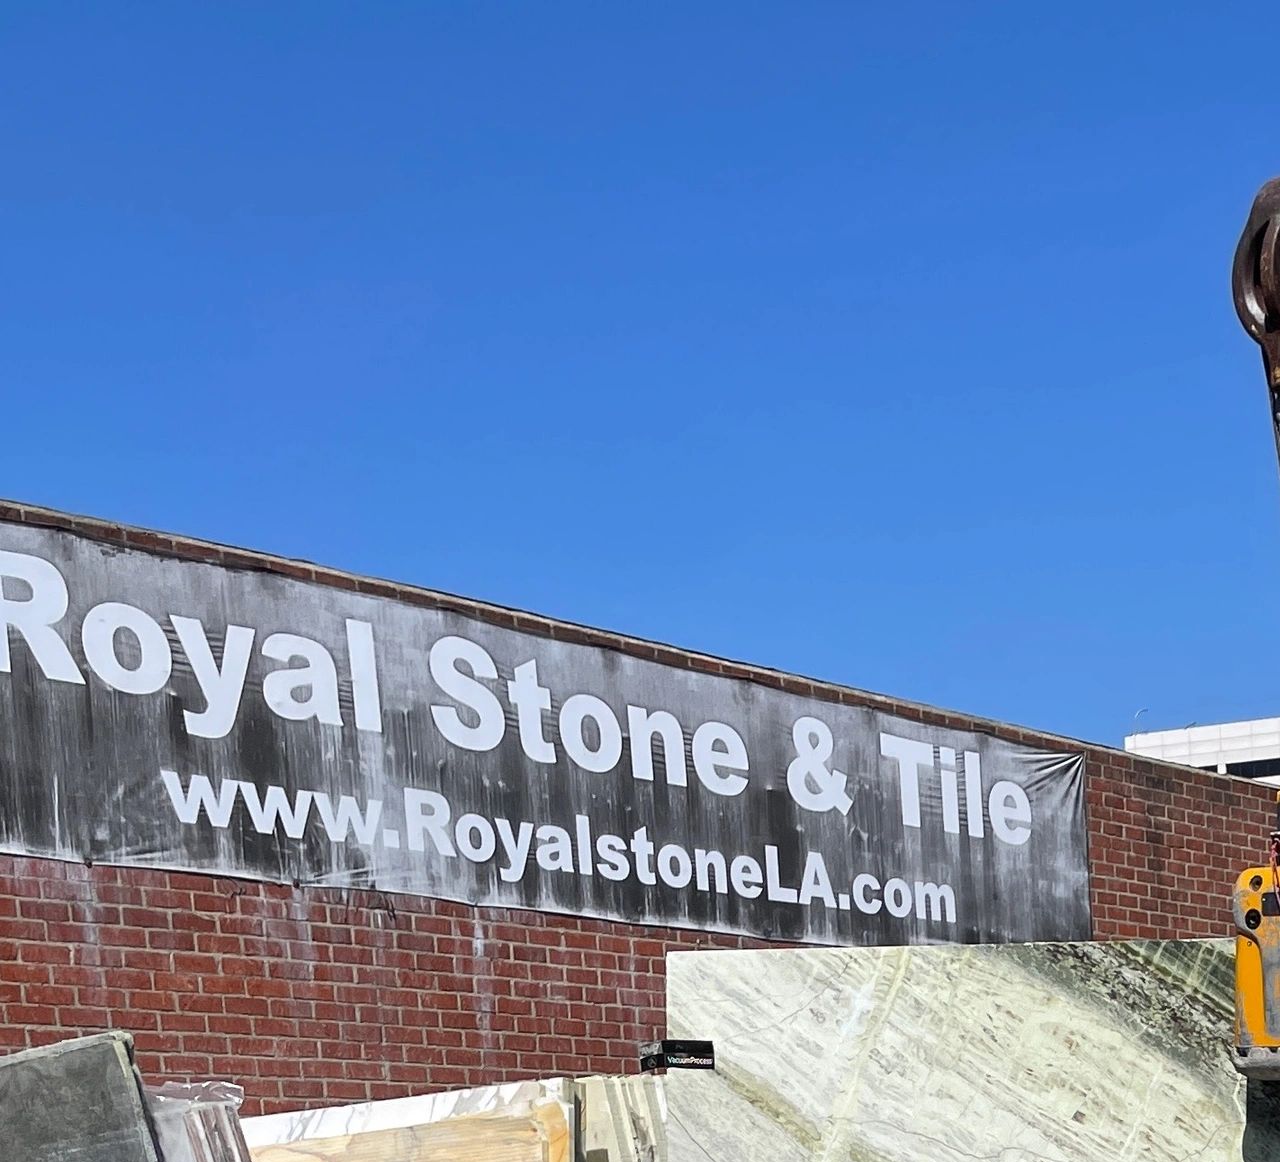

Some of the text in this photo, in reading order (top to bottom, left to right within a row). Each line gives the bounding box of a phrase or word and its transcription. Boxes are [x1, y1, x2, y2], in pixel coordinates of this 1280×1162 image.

[0, 549, 1032, 846] Royal Stone & Tile
[160, 768, 957, 924] www.RoyalstoneLA.com
